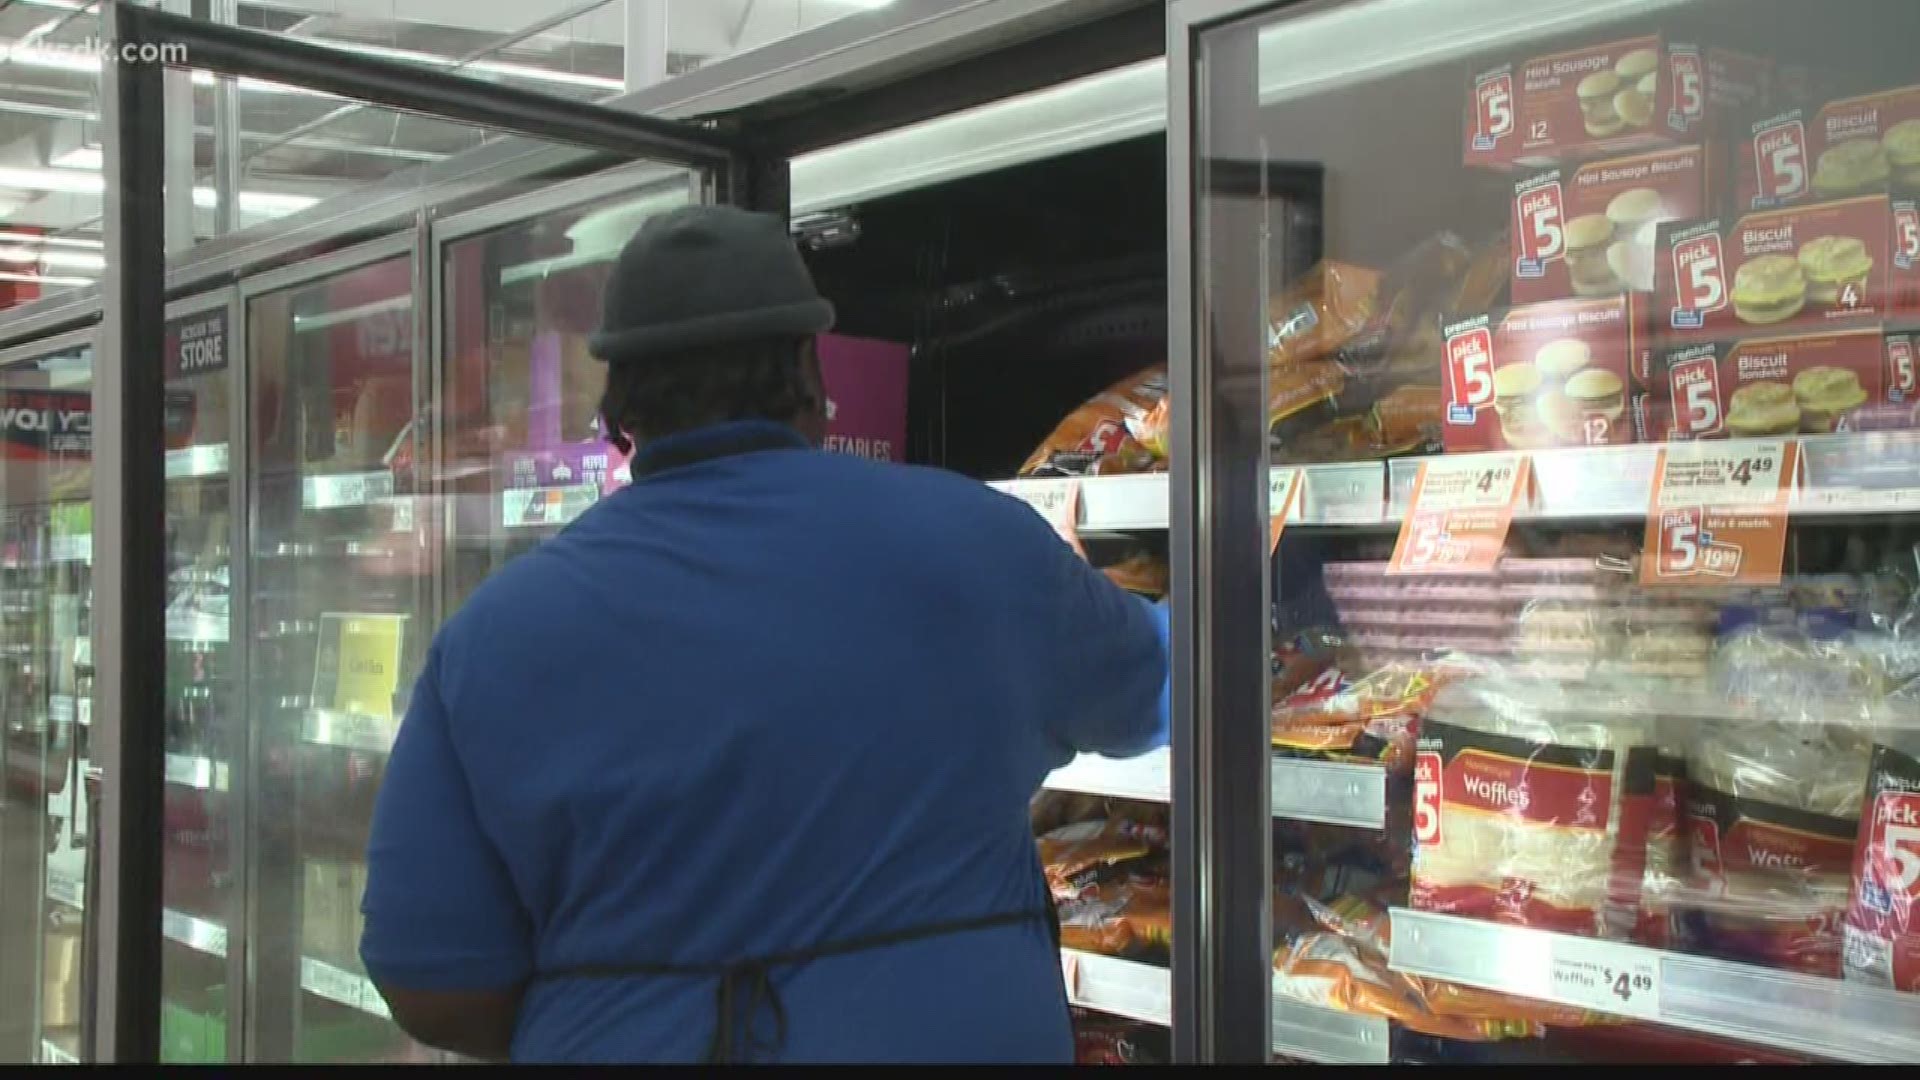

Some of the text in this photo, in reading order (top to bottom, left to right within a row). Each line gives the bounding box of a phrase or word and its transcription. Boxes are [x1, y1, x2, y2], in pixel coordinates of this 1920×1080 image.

[1554, 55, 1609, 74] Sausage
[1682, 72, 1700, 114] 5
[1489, 95, 1511, 134] 5
[1826, 109, 1878, 130] Biscuit
[1531, 120, 1548, 139] 12
[1761, 132, 1793, 156] pick
[1515, 169, 1560, 193] premium
[1601, 165, 1649, 183] Sausage
[1651, 156, 1695, 174] Biscuits
[1773, 145, 1803, 194] 5
[1523, 193, 1552, 217] pick
[1534, 207, 1563, 257] 5
[1670, 218, 1720, 243] premium
[1743, 224, 1792, 244] Biscuit
[1904, 224, 1919, 256] 5
[1679, 244, 1710, 268] pick
[1691, 257, 1722, 308] 5
[1840, 283, 1857, 308] 4
[1444, 314, 1489, 337] premium
[1578, 308, 1622, 325] Biscuits
[181, 334, 223, 370] STORE
[1453, 337, 1482, 362] pick
[1667, 342, 1716, 363] premium
[1738, 352, 1788, 369] Biscuit
[1463, 352, 1493, 404] 5
[1675, 368, 1707, 390] pick
[1738, 366, 1788, 382] Sandwich
[1898, 356, 1913, 389] 5
[1686, 382, 1718, 432] 5
[1583, 419, 1609, 444] 12
[823, 433, 892, 462] ETABLES
[1664, 510, 1693, 530] pick
[1670, 525, 1698, 570] 5
[1414, 761, 1432, 781] ick
[1463, 772, 1530, 808] Waffles
[1415, 780, 1438, 841] 5
[1876, 803, 1917, 825] pick
[1884, 825, 1920, 891] 5
[1553, 970, 1595, 987] Waffles
